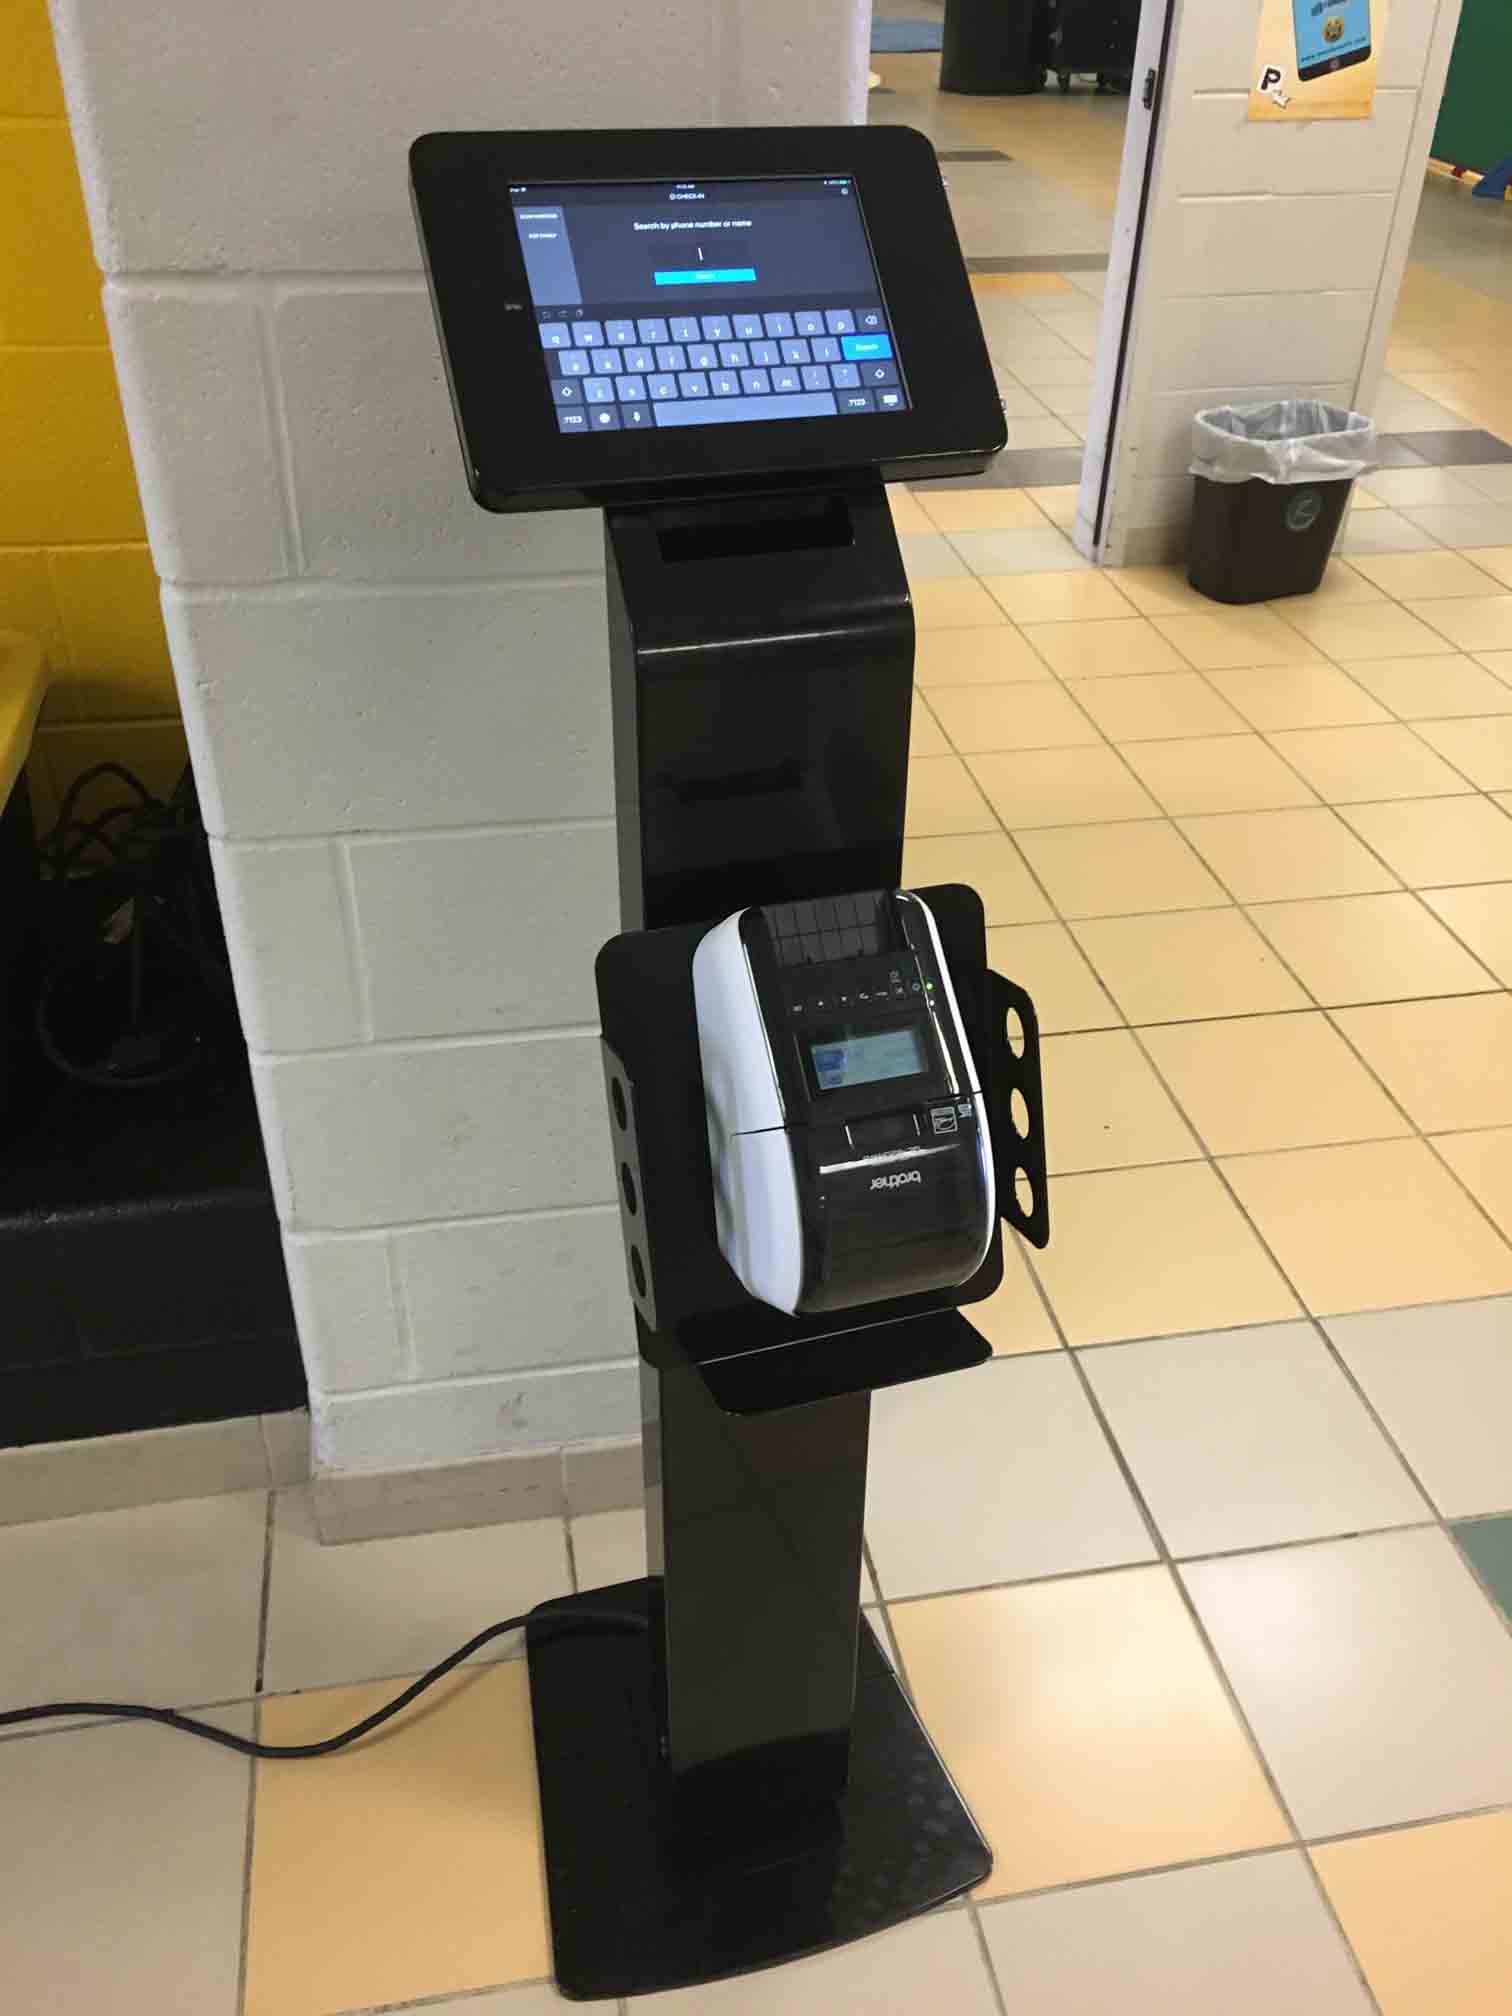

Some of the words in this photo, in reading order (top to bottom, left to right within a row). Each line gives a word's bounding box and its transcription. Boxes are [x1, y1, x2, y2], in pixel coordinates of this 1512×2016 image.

[1260, 67, 1282, 91] P
[633, 222, 660, 231] Search
[660, 222, 670, 231] by
[671, 221, 694, 230] phone
[694, 220, 722, 229] number
[870, 1169, 922, 1191] brother
